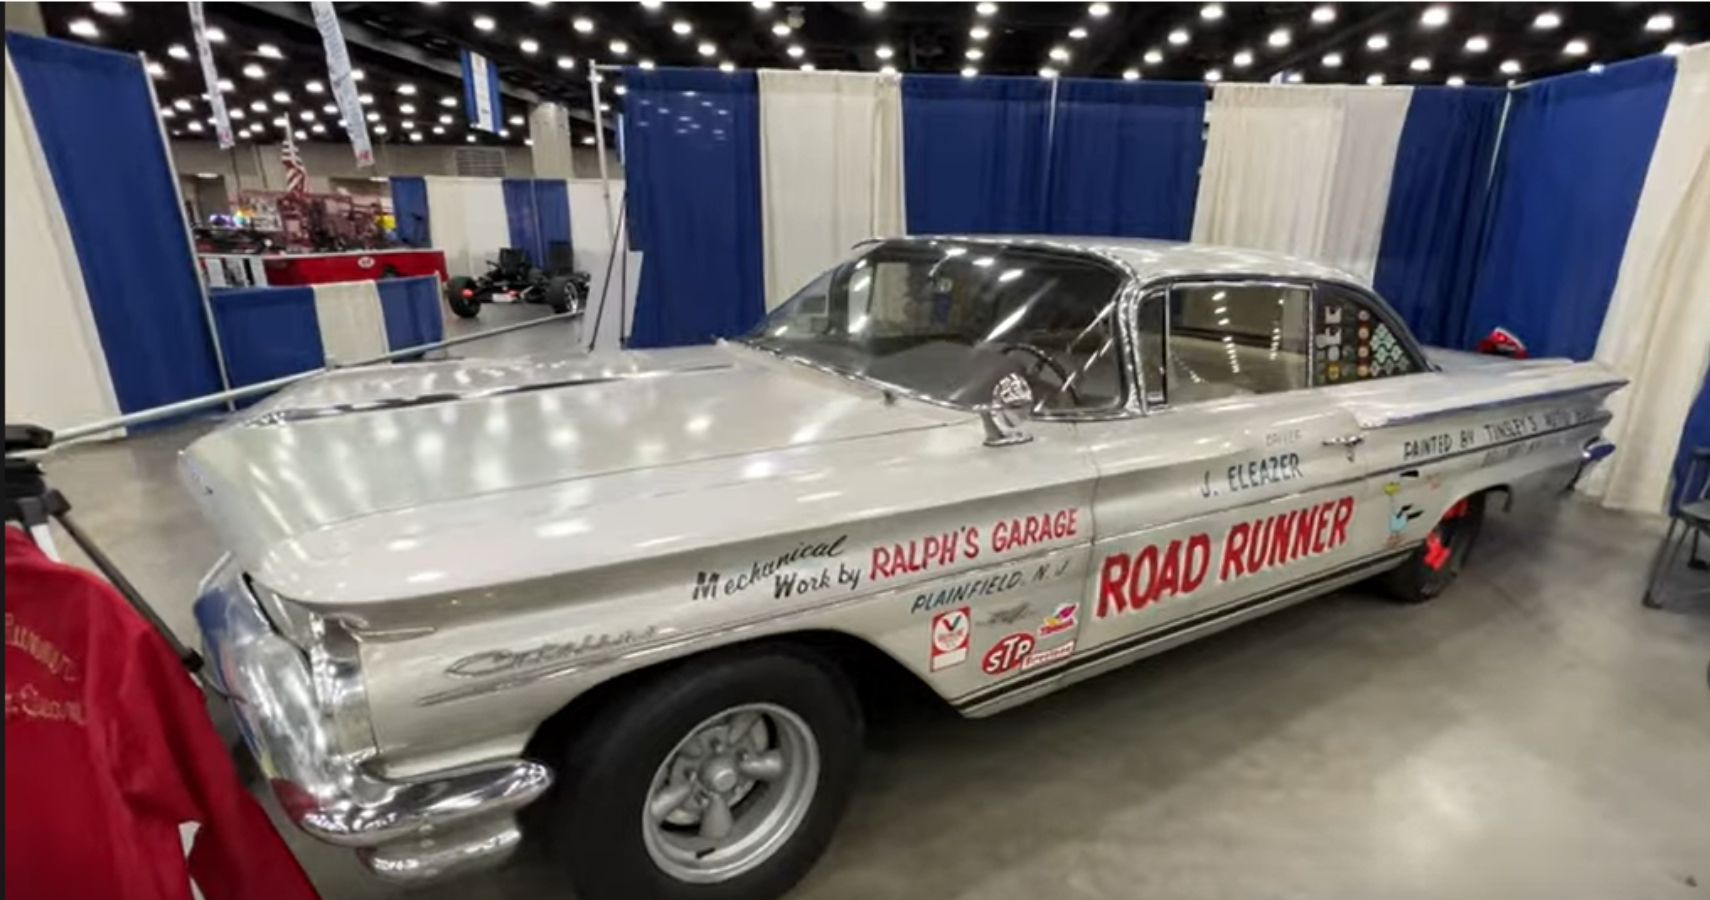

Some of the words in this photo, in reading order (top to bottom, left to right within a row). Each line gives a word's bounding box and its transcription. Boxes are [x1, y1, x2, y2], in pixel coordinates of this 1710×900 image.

[1403, 433, 1453, 461] PAINTED
[1460, 428, 1474, 449] BY
[1200, 470, 1218, 498] J.
[1227, 453, 1303, 493] ELEAZER
[869, 524, 980, 581] RALPH'S
[991, 507, 1079, 553] GARAGE
[1096, 533, 1210, 618] ROAD
[1219, 495, 1354, 582] RUNNER
[692, 535, 848, 601] Mechanical
[773, 567, 831, 600] Work
[838, 565, 862, 590] by
[986, 636, 1032, 672] STP
